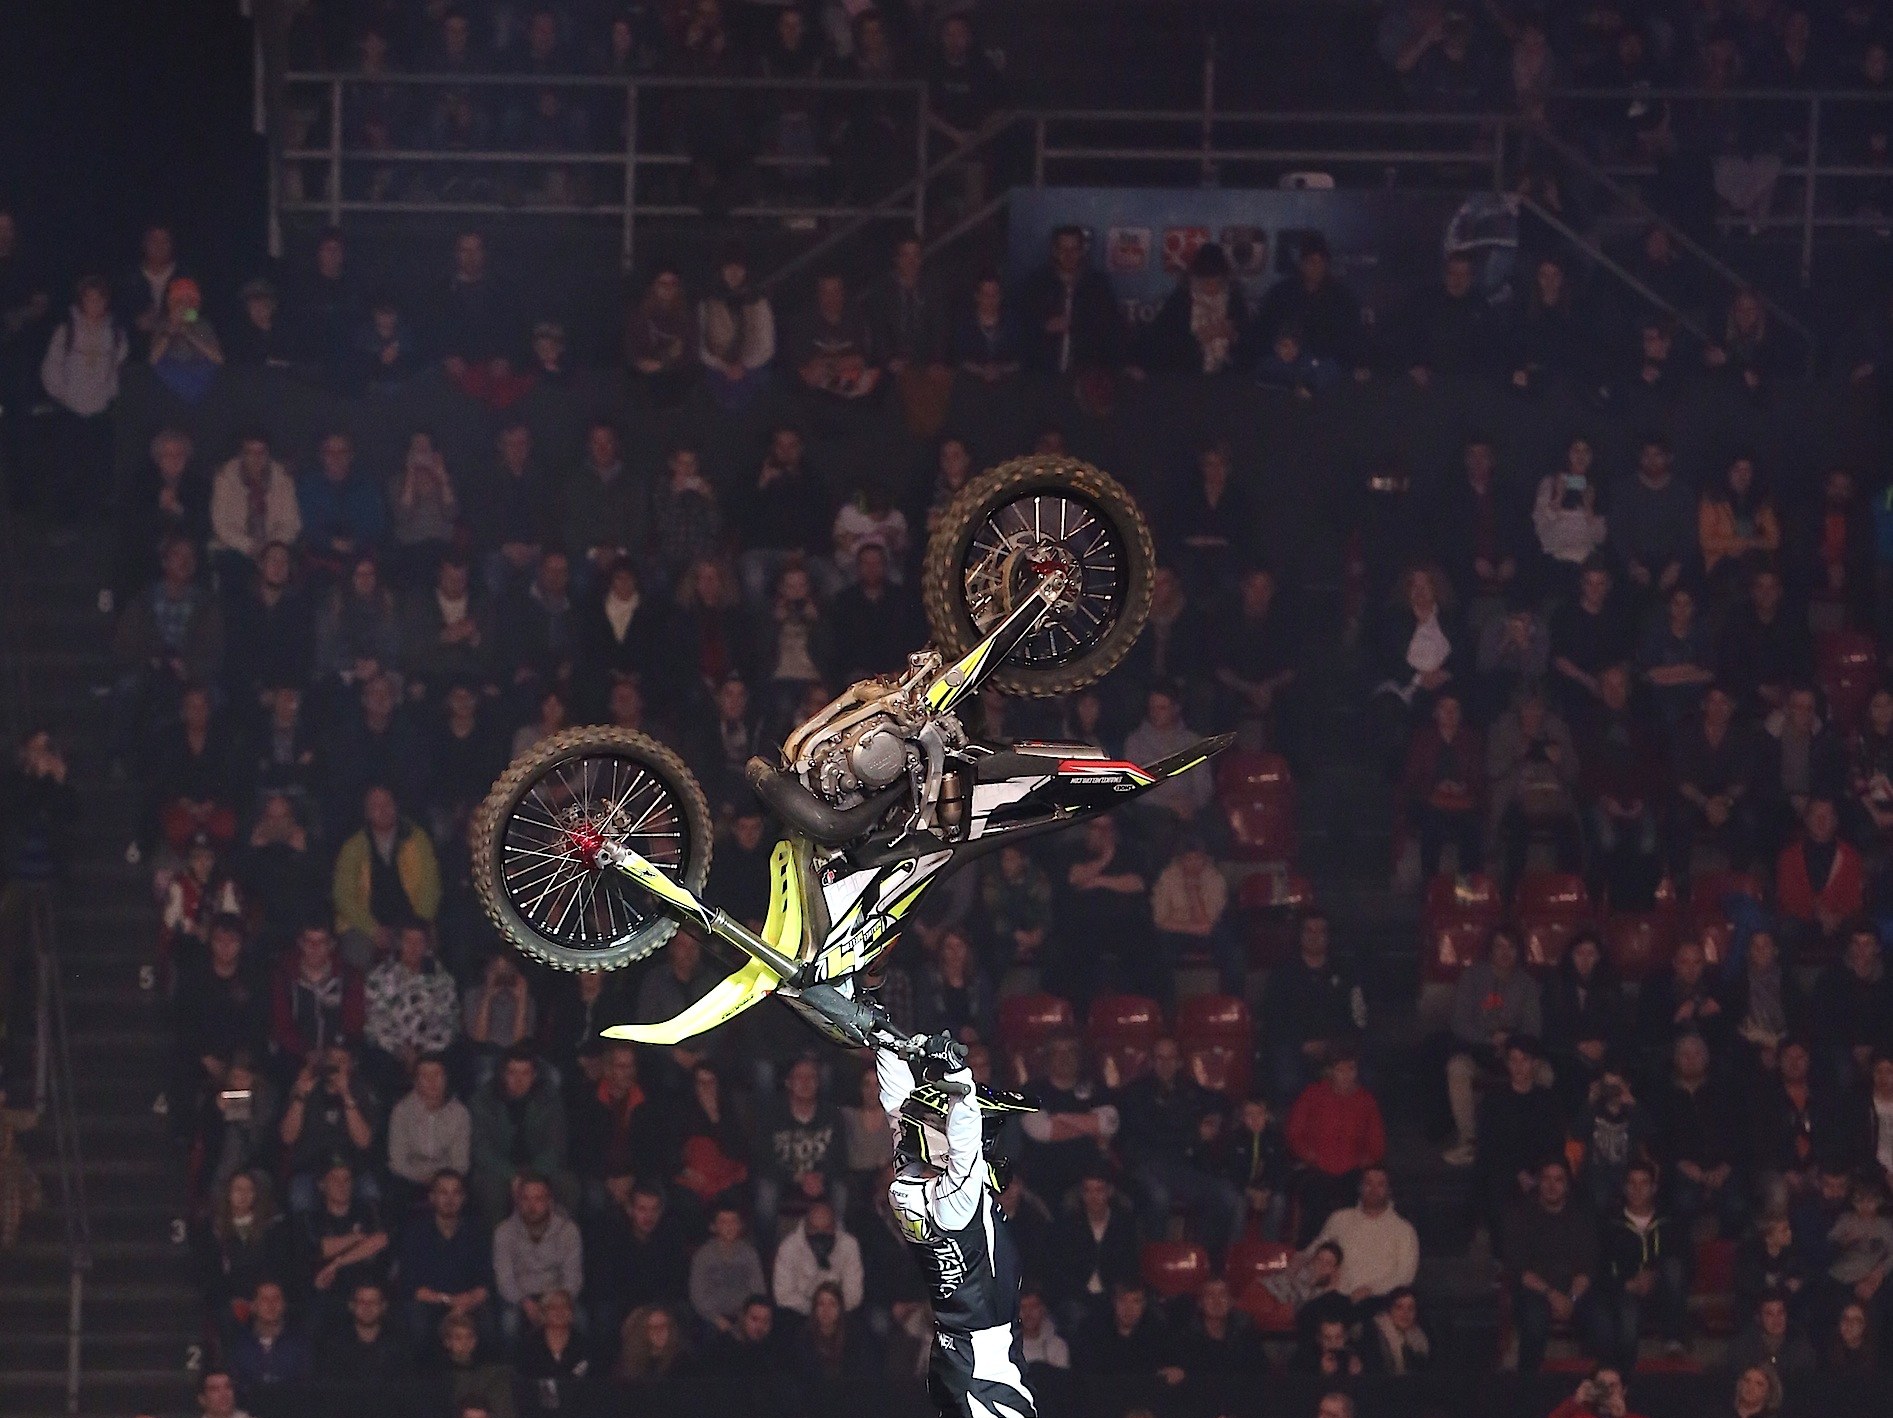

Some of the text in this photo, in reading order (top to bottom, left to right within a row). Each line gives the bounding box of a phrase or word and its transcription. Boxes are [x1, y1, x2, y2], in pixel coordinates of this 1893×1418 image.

[139, 964, 154, 990] 5
[171, 1218, 186, 1243] 3
[186, 1344, 202, 1370] 2
